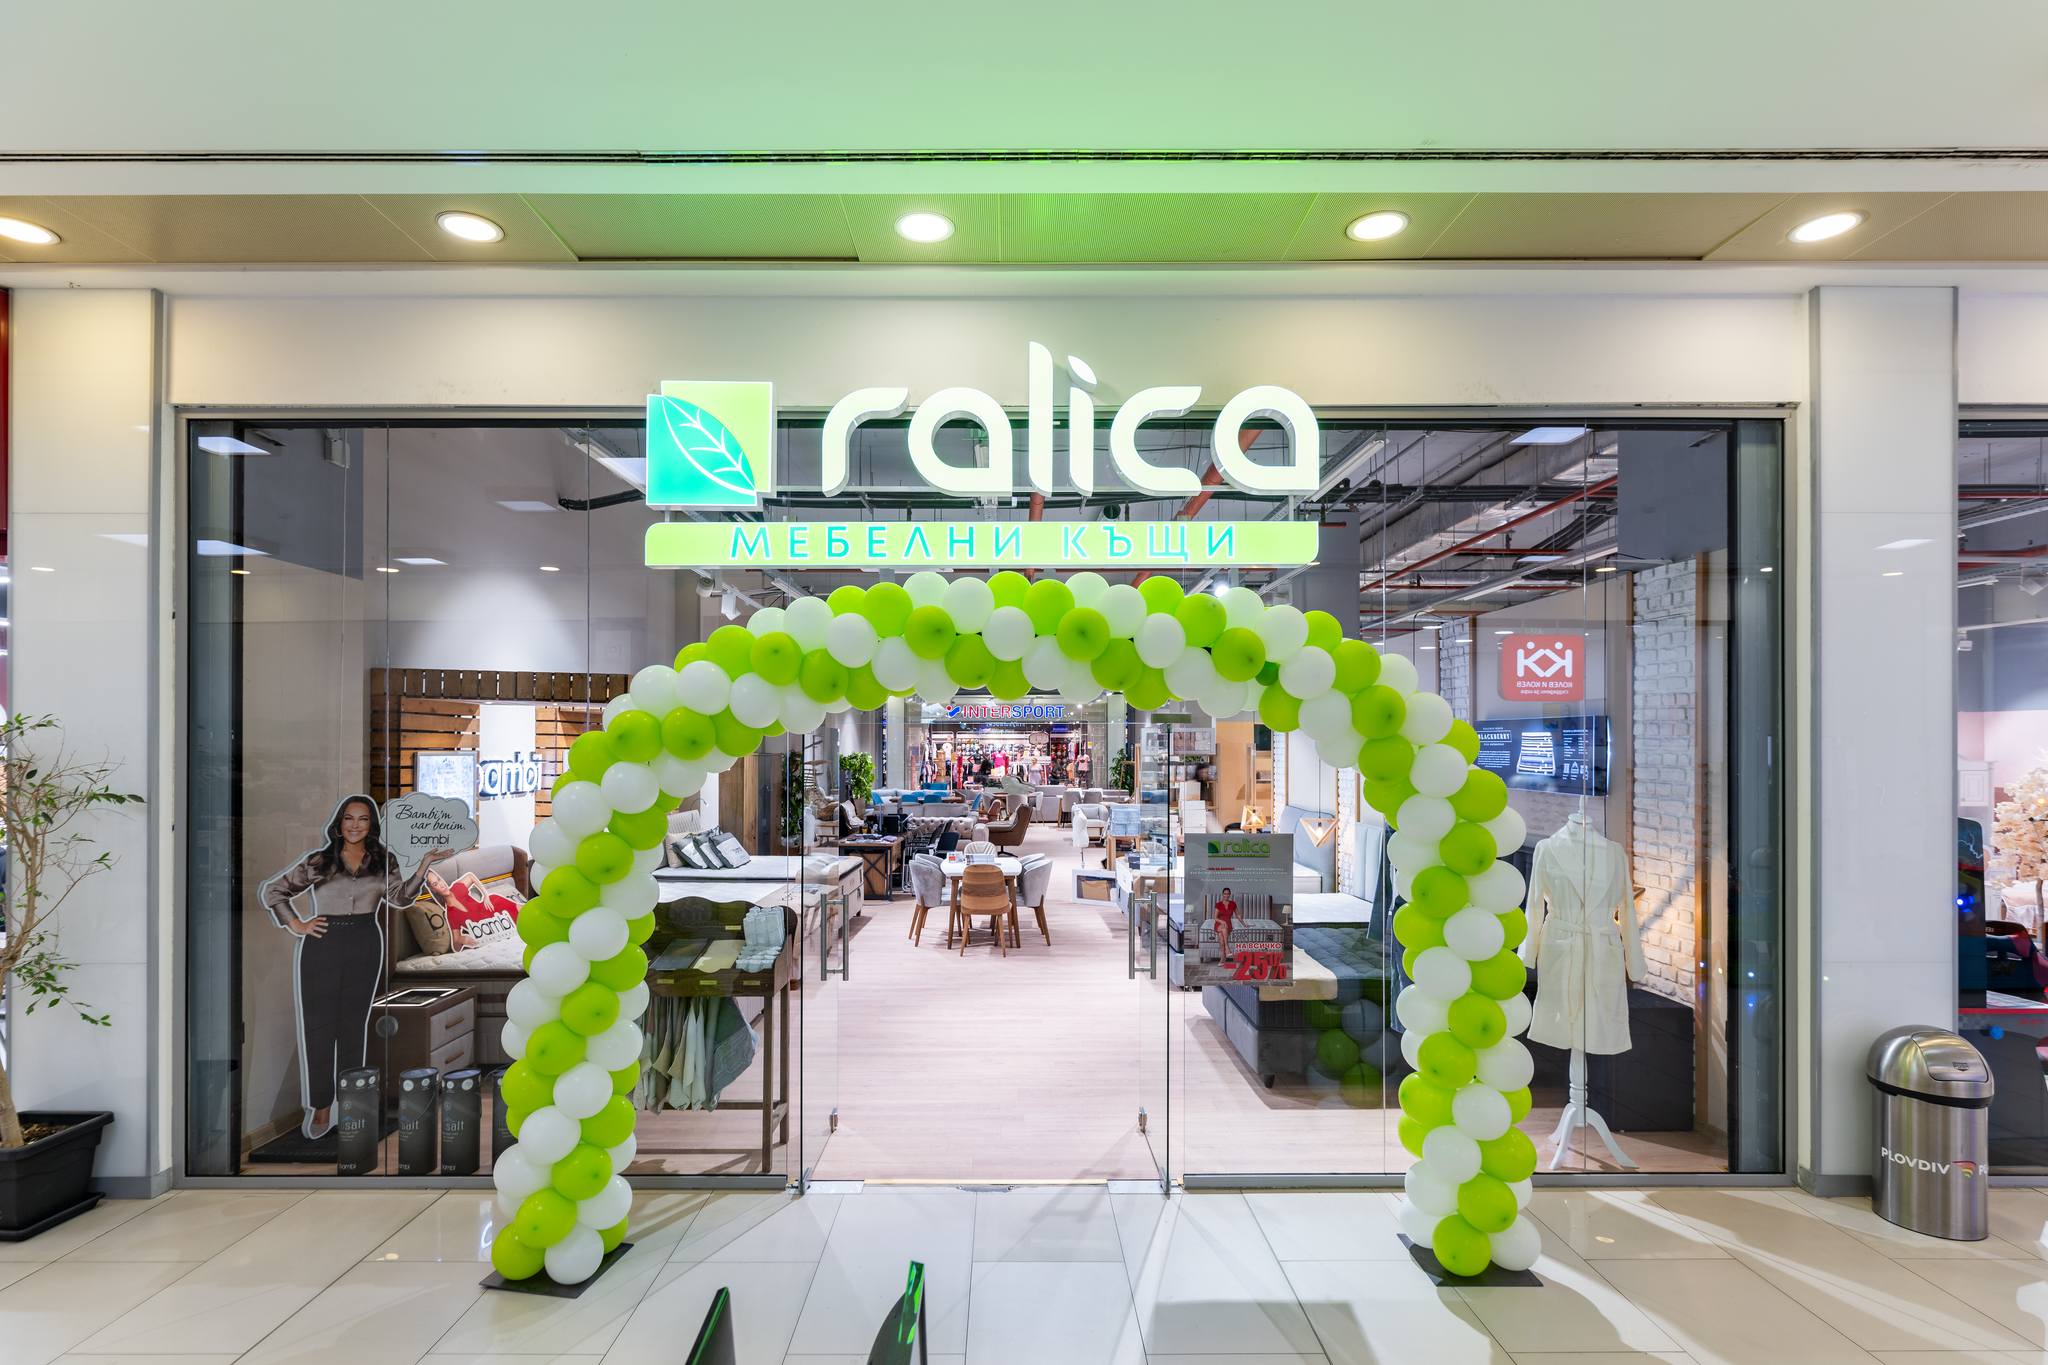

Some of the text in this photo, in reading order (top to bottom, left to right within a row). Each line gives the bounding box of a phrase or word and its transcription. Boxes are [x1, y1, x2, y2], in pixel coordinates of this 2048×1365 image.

[822, 341, 1320, 498] ralica
[730, 525, 1236, 562] МЕБЕЛНИ КЪЩИ
[963, 705, 1065, 719] INTERSPORT
[396, 804, 452, 820] Bambi'm
[410, 820, 466, 831] var benim.
[410, 834, 450, 845] bambi
[1225, 839, 1270, 854] ralica
[469, 912, 515, 939] bambi
[1224, 951, 1288, 981] -25%
[1881, 1147, 1951, 1174] PLOVDIV
